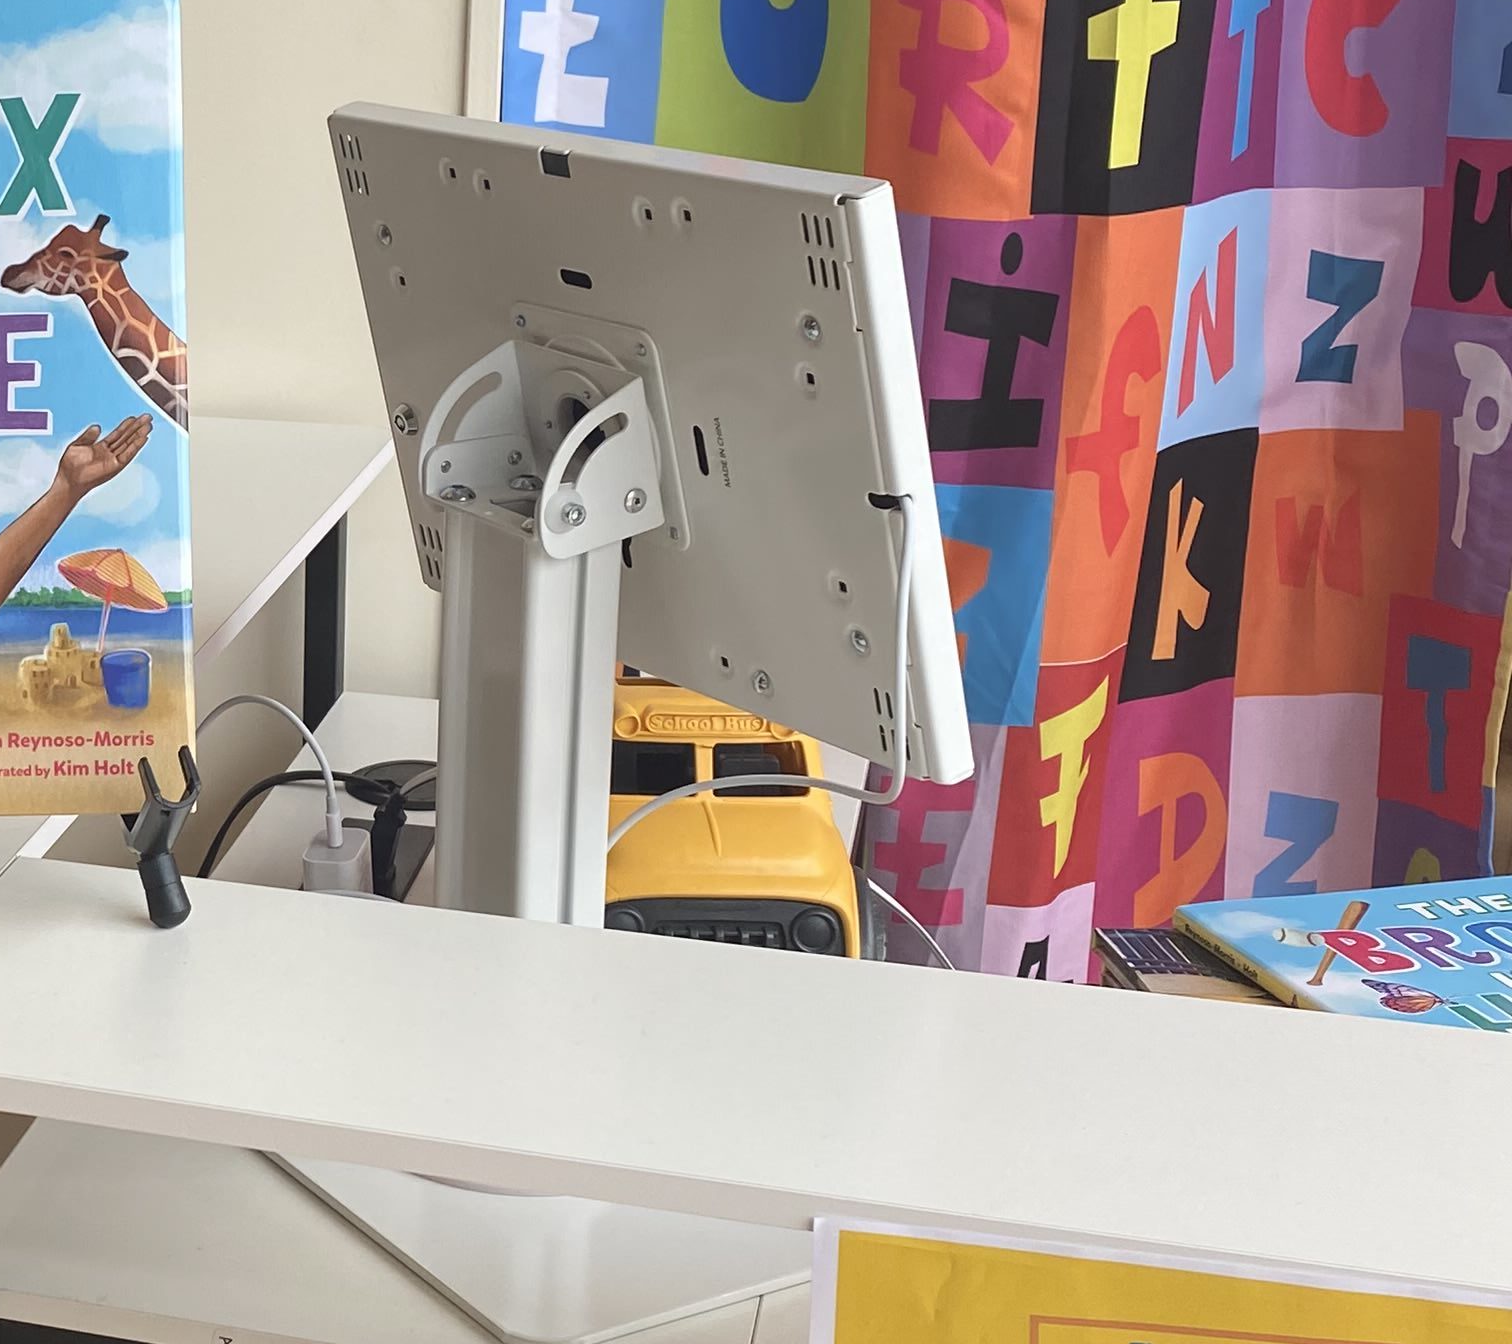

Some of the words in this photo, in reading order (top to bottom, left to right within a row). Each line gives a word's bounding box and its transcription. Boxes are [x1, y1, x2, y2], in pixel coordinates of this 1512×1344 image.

[713, 417, 724, 446] CHINA
[721, 460, 731, 488] MADE
[651, 716, 721, 731] School
[725, 717, 761, 730] Bus
[8, 730, 154, 752] Reynoso-Morris
[35, 764, 51, 779] by
[54, 759, 89, 777] Kim
[95, 758, 135, 775] Holt
[1395, 894, 1512, 920] THE
[1316, 920, 1512, 975] BRO
